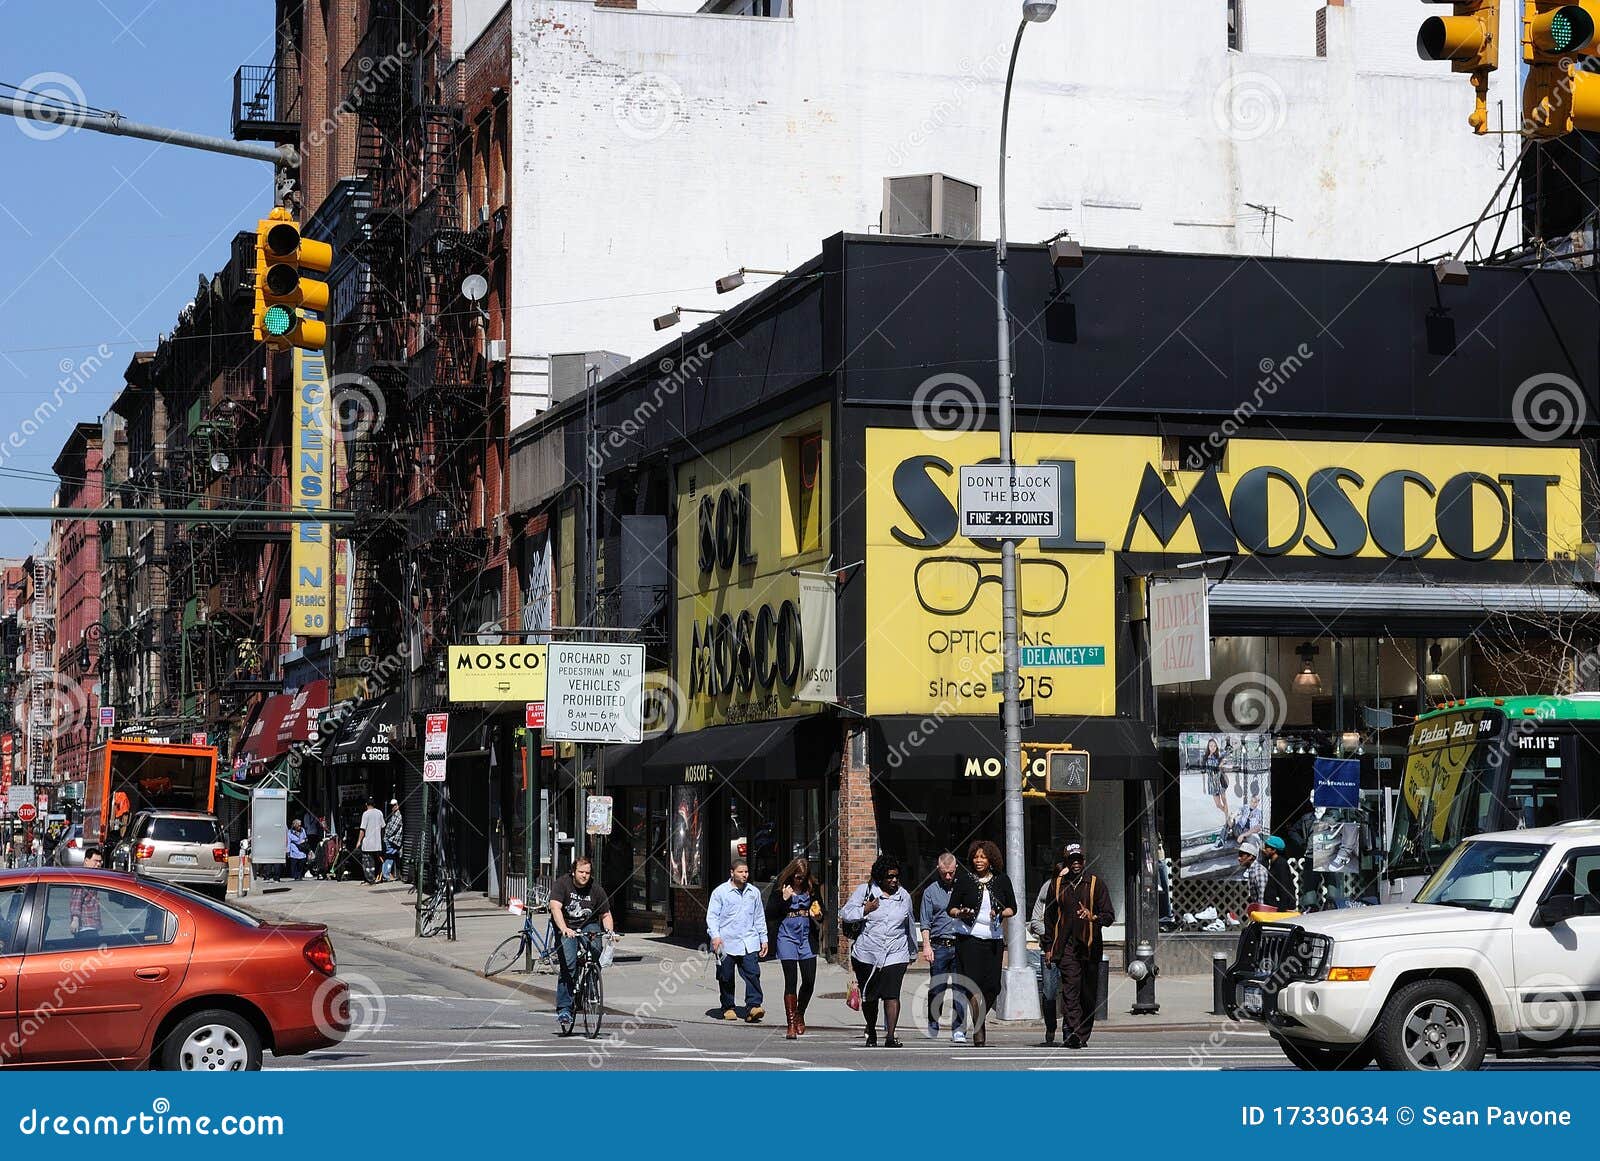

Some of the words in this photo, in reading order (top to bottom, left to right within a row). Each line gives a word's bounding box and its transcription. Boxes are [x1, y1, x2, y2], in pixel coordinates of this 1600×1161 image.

[967, 476, 1005, 487] DON'T
[1009, 476, 1051, 487] BLOCK
[983, 491, 1007, 502] THE
[1011, 491, 1036, 502] BOX
[890, 455, 1106, 554] SL
[1122, 461, 1560, 561] MOSCOT
[969, 512, 992, 524] FINE
[995, 512, 1012, 524] +2
[1015, 512, 1050, 524] POINTS
[698, 482, 758, 574] SOL
[296, 595, 326, 606] FABRICS
[1155, 592, 1200, 631] JIMMY
[304, 614, 324, 628] 30
[928, 630, 1053, 654] OPTICINS
[688, 600, 804, 700] MOSCO
[1027, 648, 1085, 664] DELANCEY
[1088, 648, 1099, 657] ST
[1162, 634, 1195, 671] JAZZ
[559, 652, 610, 665] ORCHARD
[620, 654, 632, 665] ST
[559, 666, 604, 676] PEDESTRIAN
[612, 669, 632, 677] MALL
[569, 679, 621, 692] VEHICLES
[929, 678, 987, 698] since
[1018, 676, 1053, 699] 15
[562, 694, 626, 707] PROHIBITED
[567, 709, 574, 718] 8
[575, 711, 587, 719] AM
[600, 711, 607, 720] 6
[608, 712, 620, 720] PM
[570, 721, 617, 732] SUNDAY
[1417, 723, 1450, 745] Peter
[1451, 720, 1474, 738] Pan
[964, 758, 1047, 777] MOO
[19, 808, 35, 816] STOP
